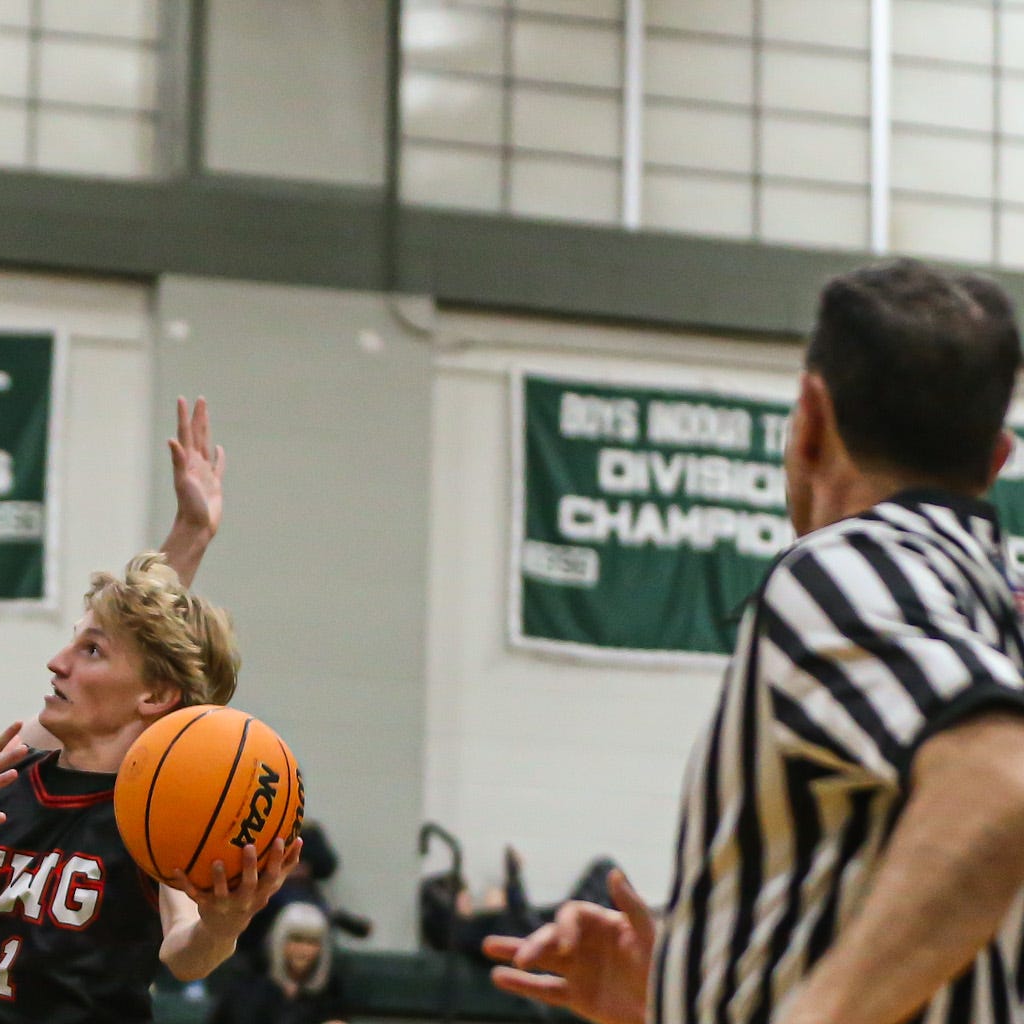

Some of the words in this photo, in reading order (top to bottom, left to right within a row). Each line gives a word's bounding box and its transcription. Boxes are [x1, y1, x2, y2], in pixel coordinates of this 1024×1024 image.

[560, 392, 639, 441] BOYS
[598, 448, 788, 507] DIVISIO
[558, 495, 797, 558] CHAMPIO
[229, 763, 280, 848] NCAA
